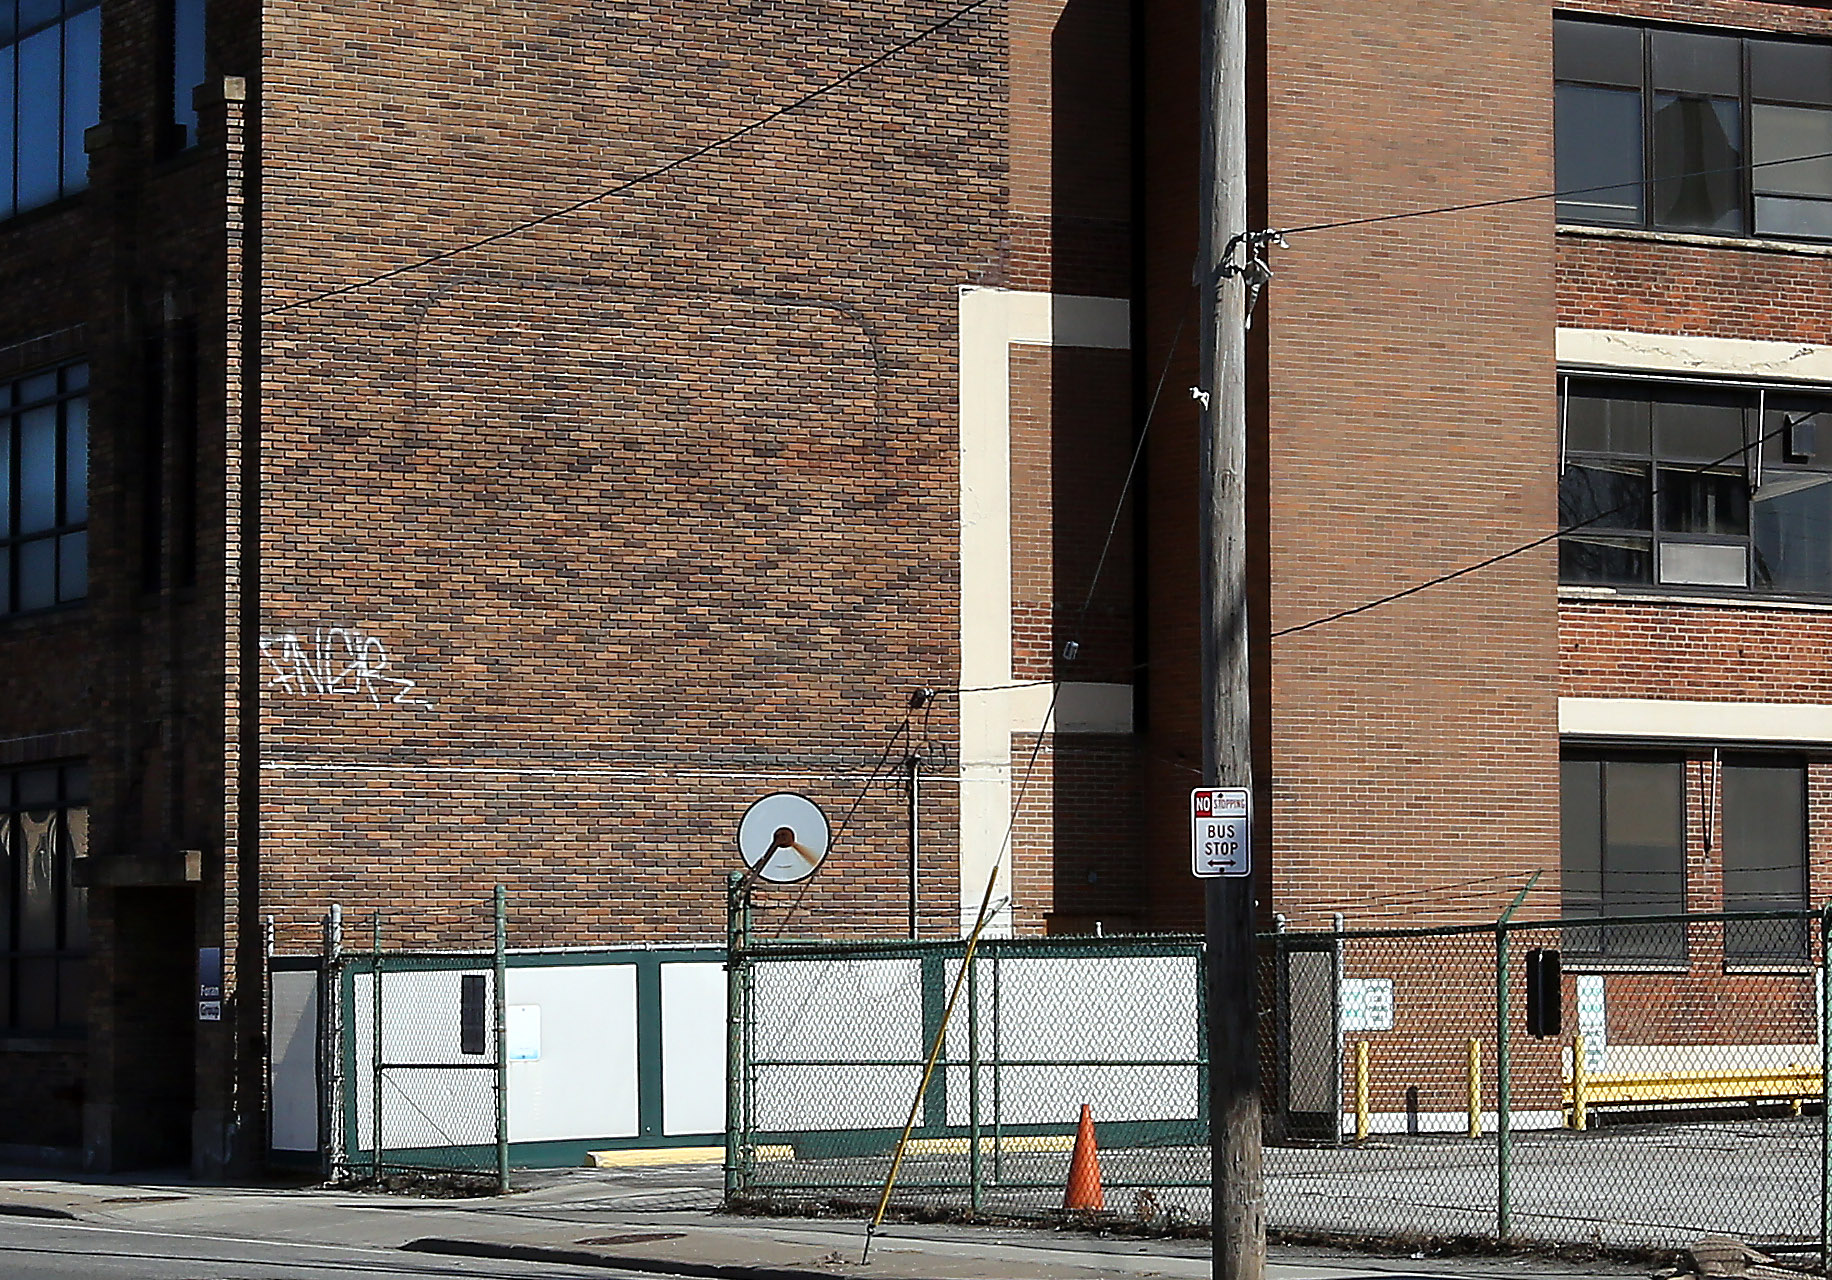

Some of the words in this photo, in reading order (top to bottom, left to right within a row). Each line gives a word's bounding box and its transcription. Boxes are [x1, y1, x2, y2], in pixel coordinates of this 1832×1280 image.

[1196, 796, 1211, 812] NO
[1213, 799, 1246, 809] STOPPING
[1208, 824, 1235, 838] BUS
[1205, 841, 1238, 856] STOP
